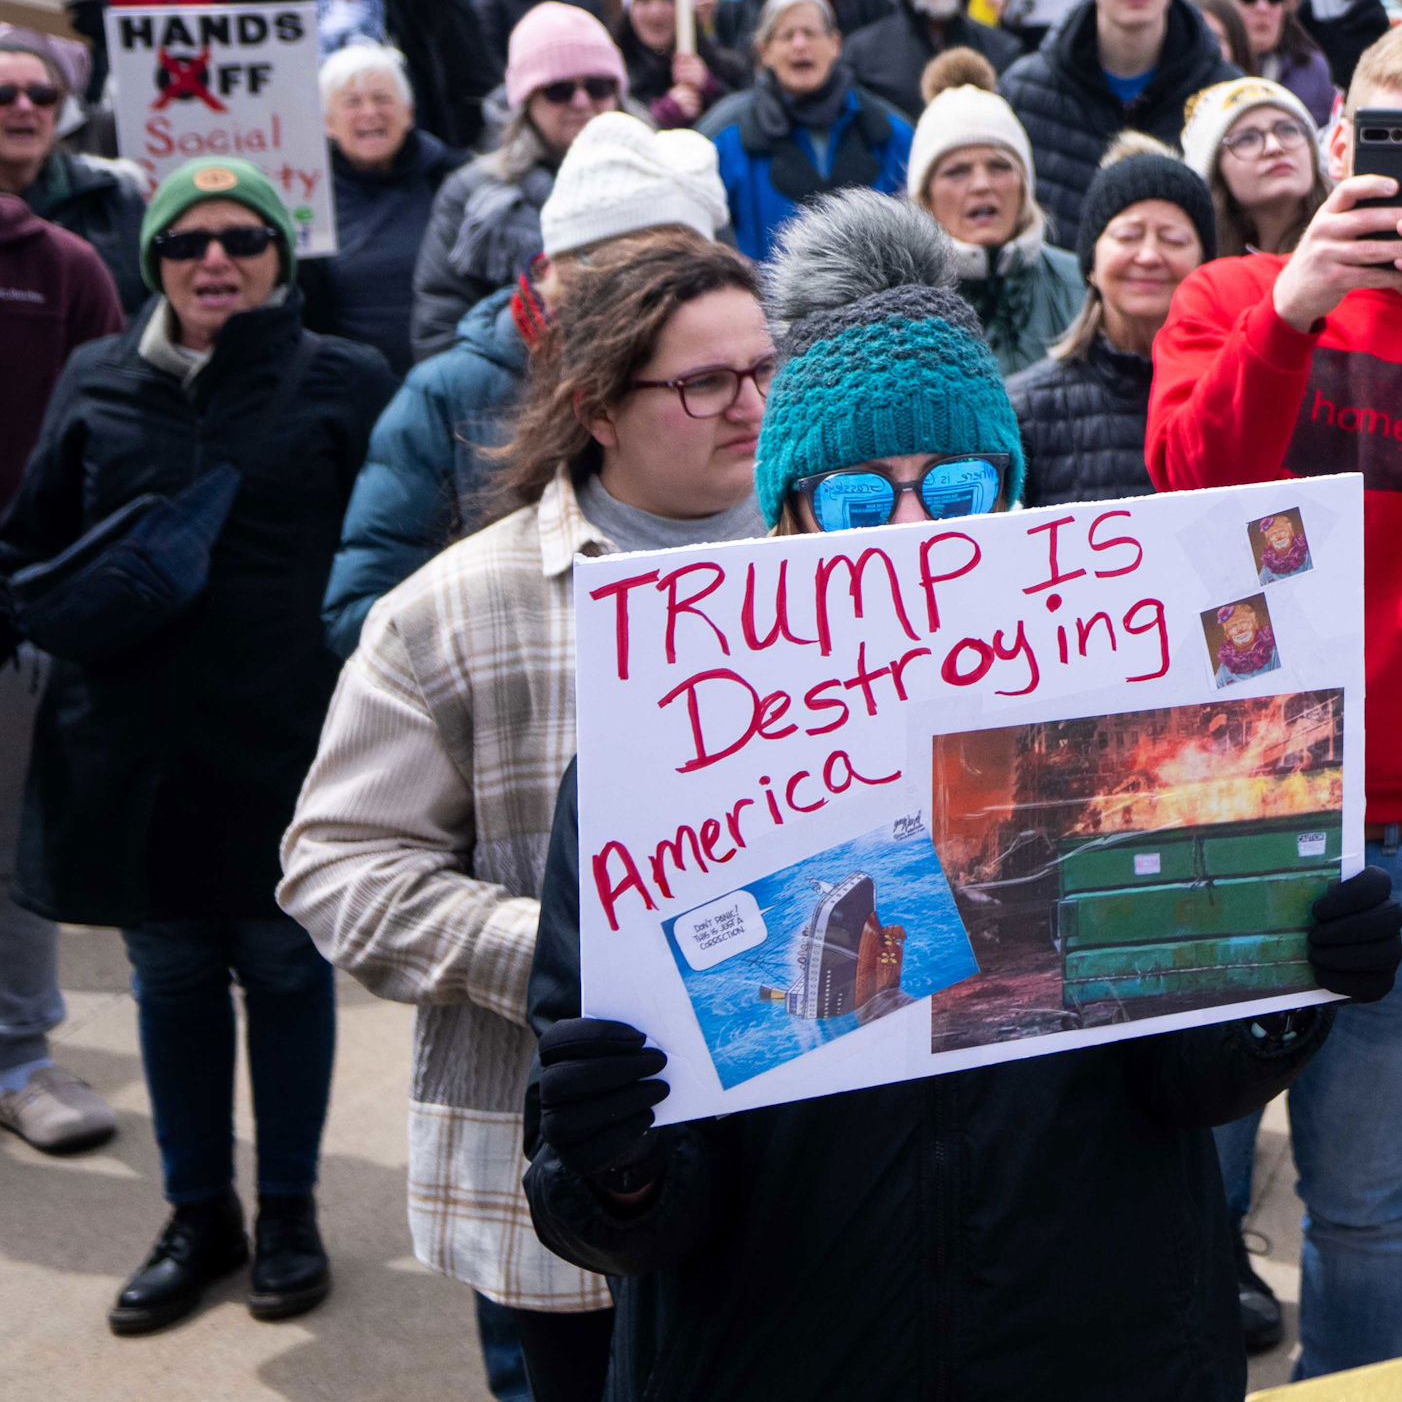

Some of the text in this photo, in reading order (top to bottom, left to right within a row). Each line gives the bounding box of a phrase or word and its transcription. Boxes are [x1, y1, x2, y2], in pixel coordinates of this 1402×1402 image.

[119, 11, 304, 50] HANDS
[145, 112, 282, 158] Social
[589, 510, 1143, 680] TRUMP IS
[658, 593, 1171, 773] Destroying
[592, 749, 903, 932] America
[693, 930, 710, 942] THIS
[710, 927, 718, 936] IS
[720, 918, 735, 932] JUST
[714, 904, 739, 924] PANIC!
